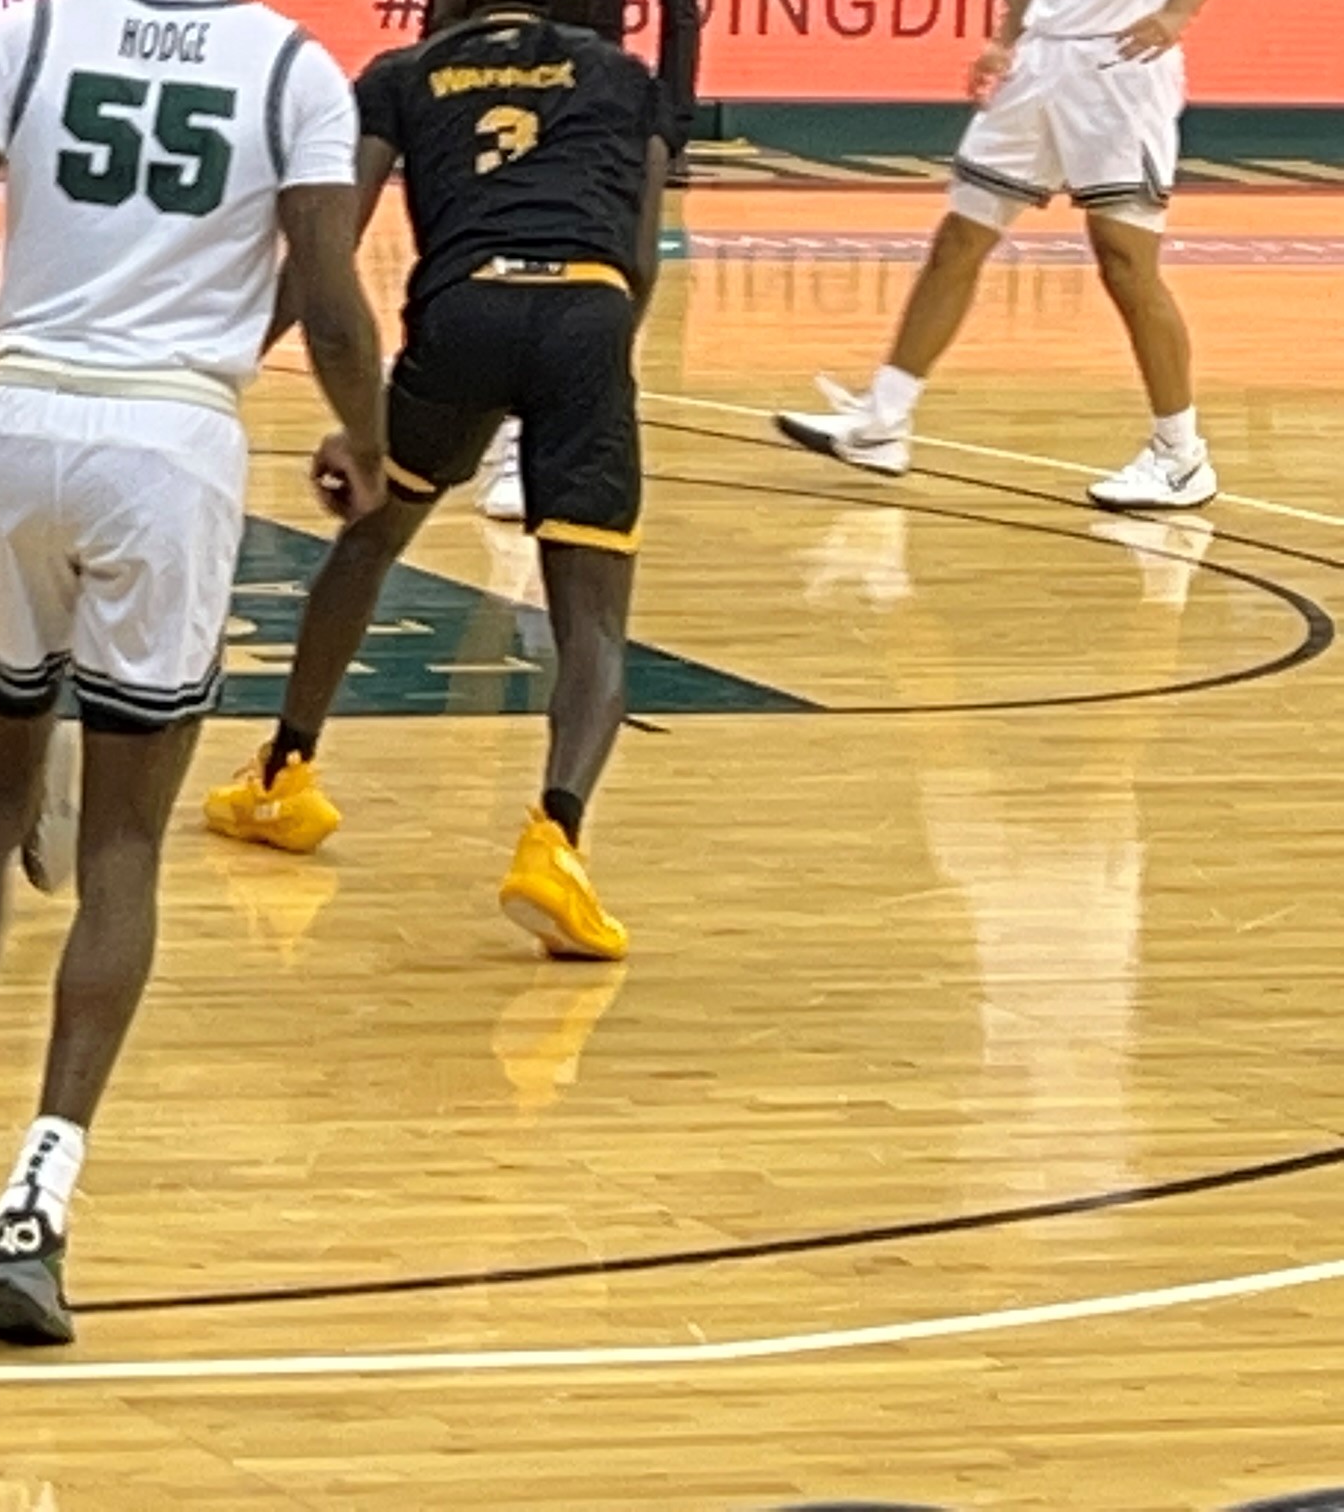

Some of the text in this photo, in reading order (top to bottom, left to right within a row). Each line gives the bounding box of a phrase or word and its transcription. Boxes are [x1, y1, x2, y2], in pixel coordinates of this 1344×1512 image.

[117, 18, 211, 64] HODGE
[54, 69, 240, 218] 55
[475, 105, 539, 175] 3
